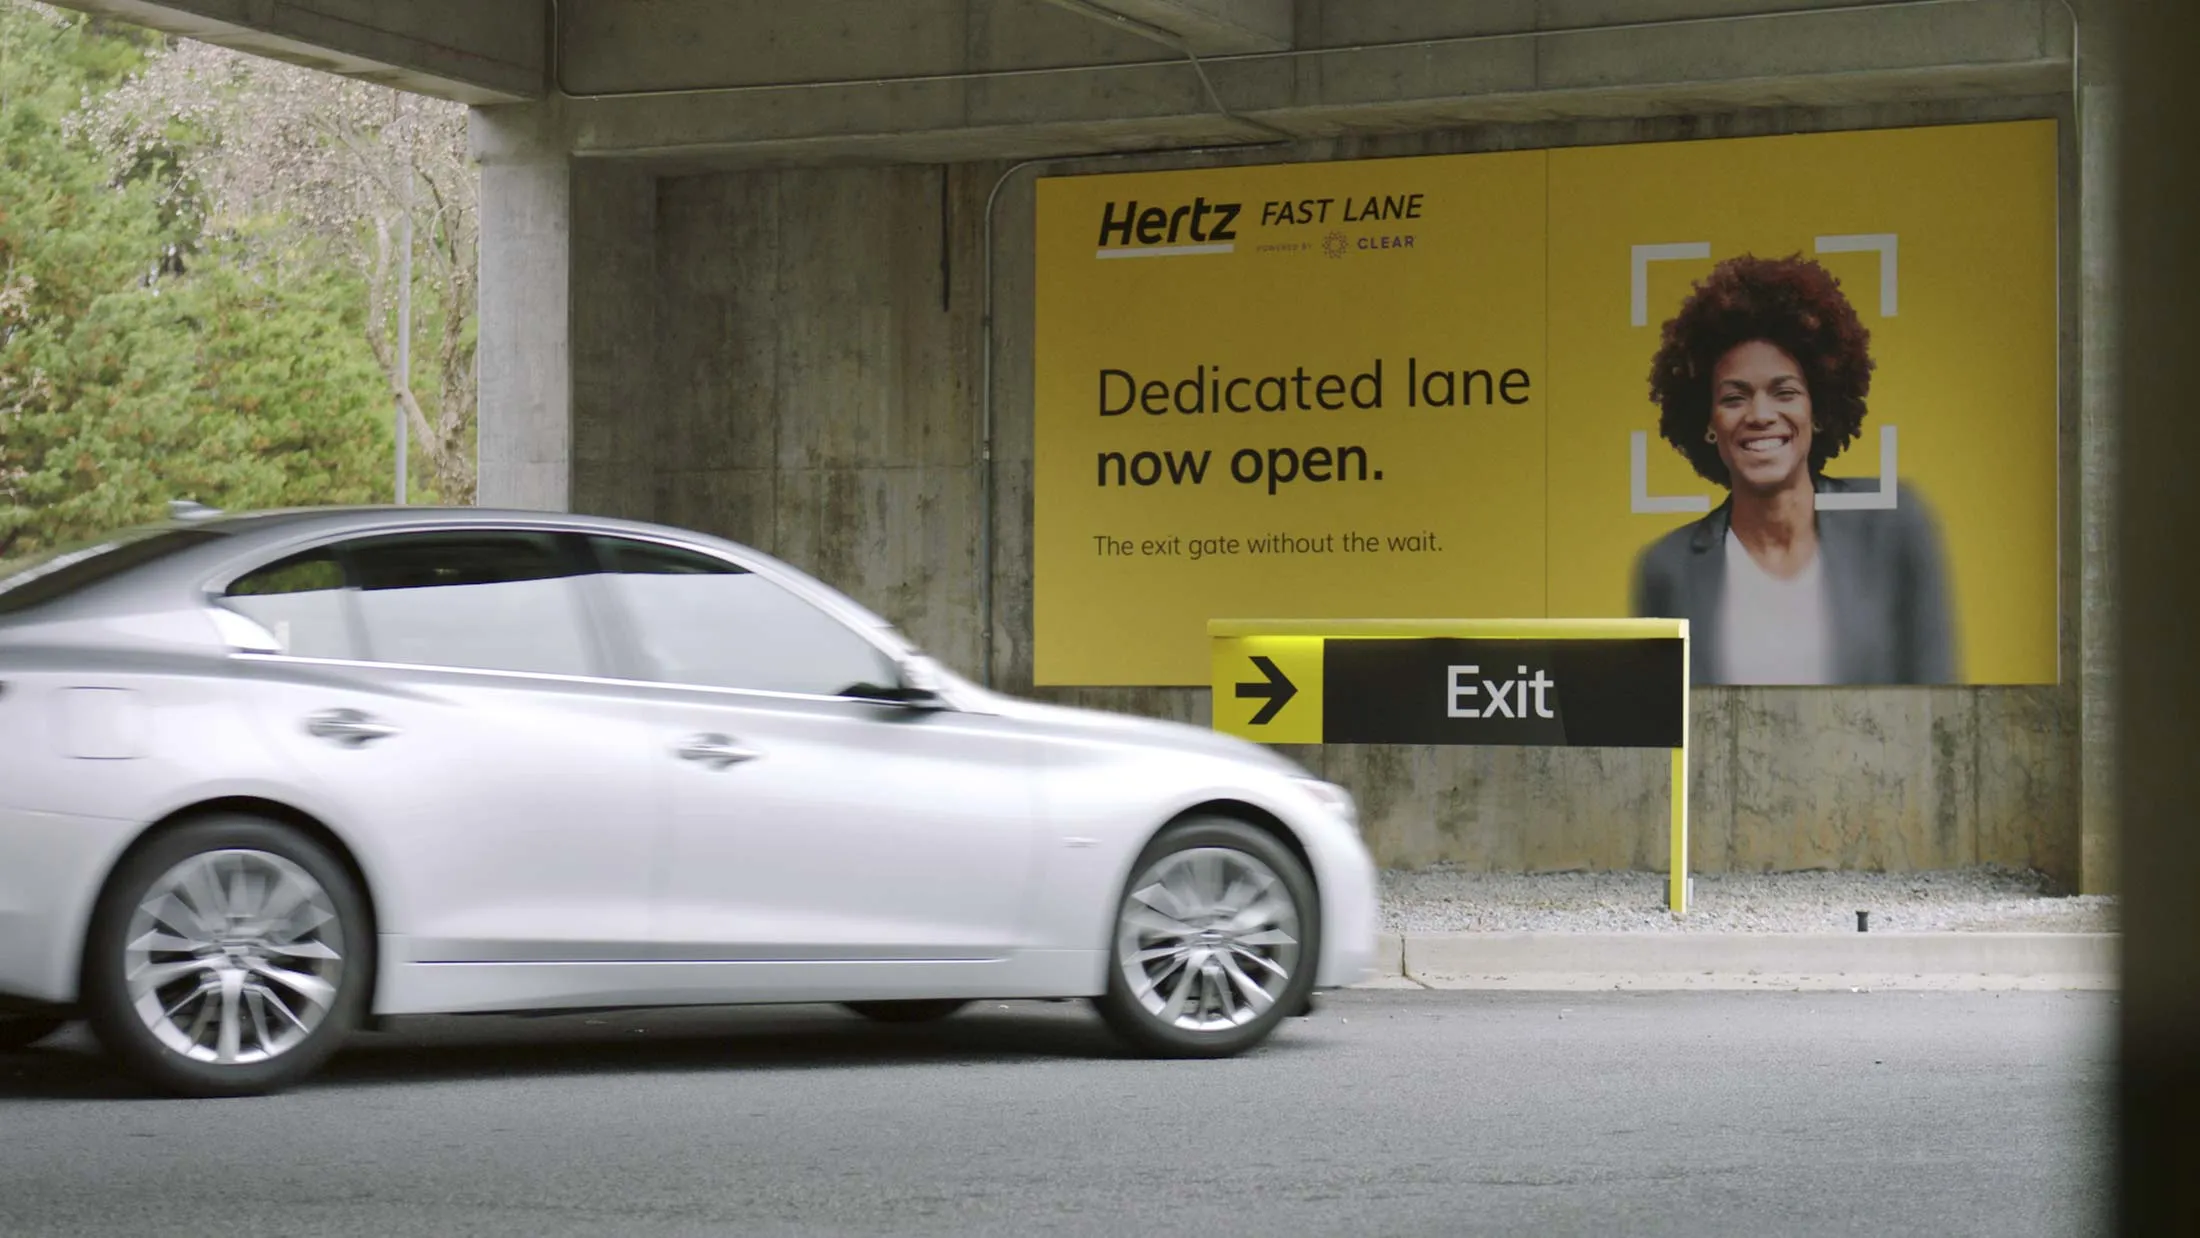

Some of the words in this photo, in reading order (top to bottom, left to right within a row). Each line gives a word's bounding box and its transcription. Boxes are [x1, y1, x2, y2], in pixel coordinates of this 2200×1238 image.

[1099, 197, 1242, 246] Hertz
[1262, 199, 1334, 226] FAST
[1344, 194, 1424, 221] LANE
[1357, 236, 1414, 249] CLEAR
[1100, 359, 1382, 416] Dedicated
[1409, 358, 1530, 407] lane
[1098, 450, 1212, 486] now
[1231, 446, 1382, 495] open.
[1094, 536, 1133, 556] The
[1141, 537, 1180, 555] exit
[1189, 536, 1239, 560] gate
[1248, 532, 1333, 553] without
[1343, 532, 1379, 552] the
[1387, 532, 1442, 552] wait.
[1448, 665, 1553, 718] Exit
